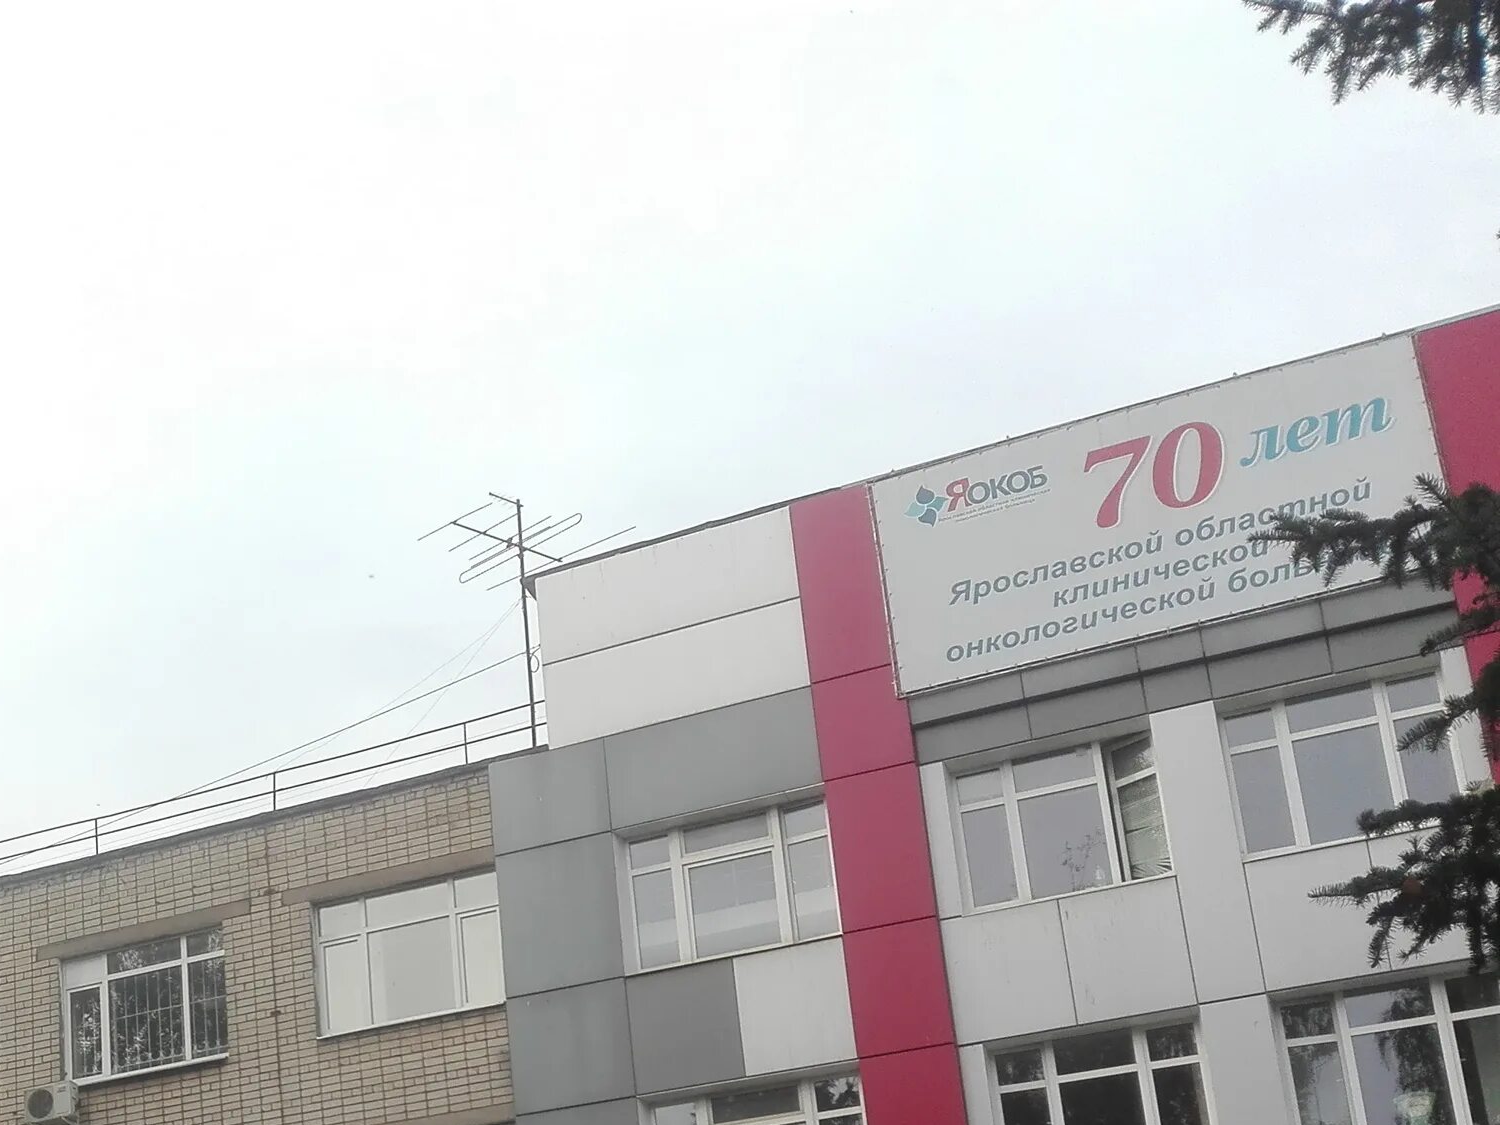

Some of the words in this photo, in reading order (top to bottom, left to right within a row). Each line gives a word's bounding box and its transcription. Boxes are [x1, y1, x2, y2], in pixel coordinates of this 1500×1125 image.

[946, 465, 1048, 512] ЯОКОБ
[1083, 421, 1224, 528] 70
[1240, 398, 1395, 467] лет
[949, 528, 1163, 605] Ярославской
[1175, 476, 1371, 546] областной
[1053, 534, 1269, 607] клинической
[946, 577, 1215, 662] онкологической
[1228, 560, 1318, 593] боль
